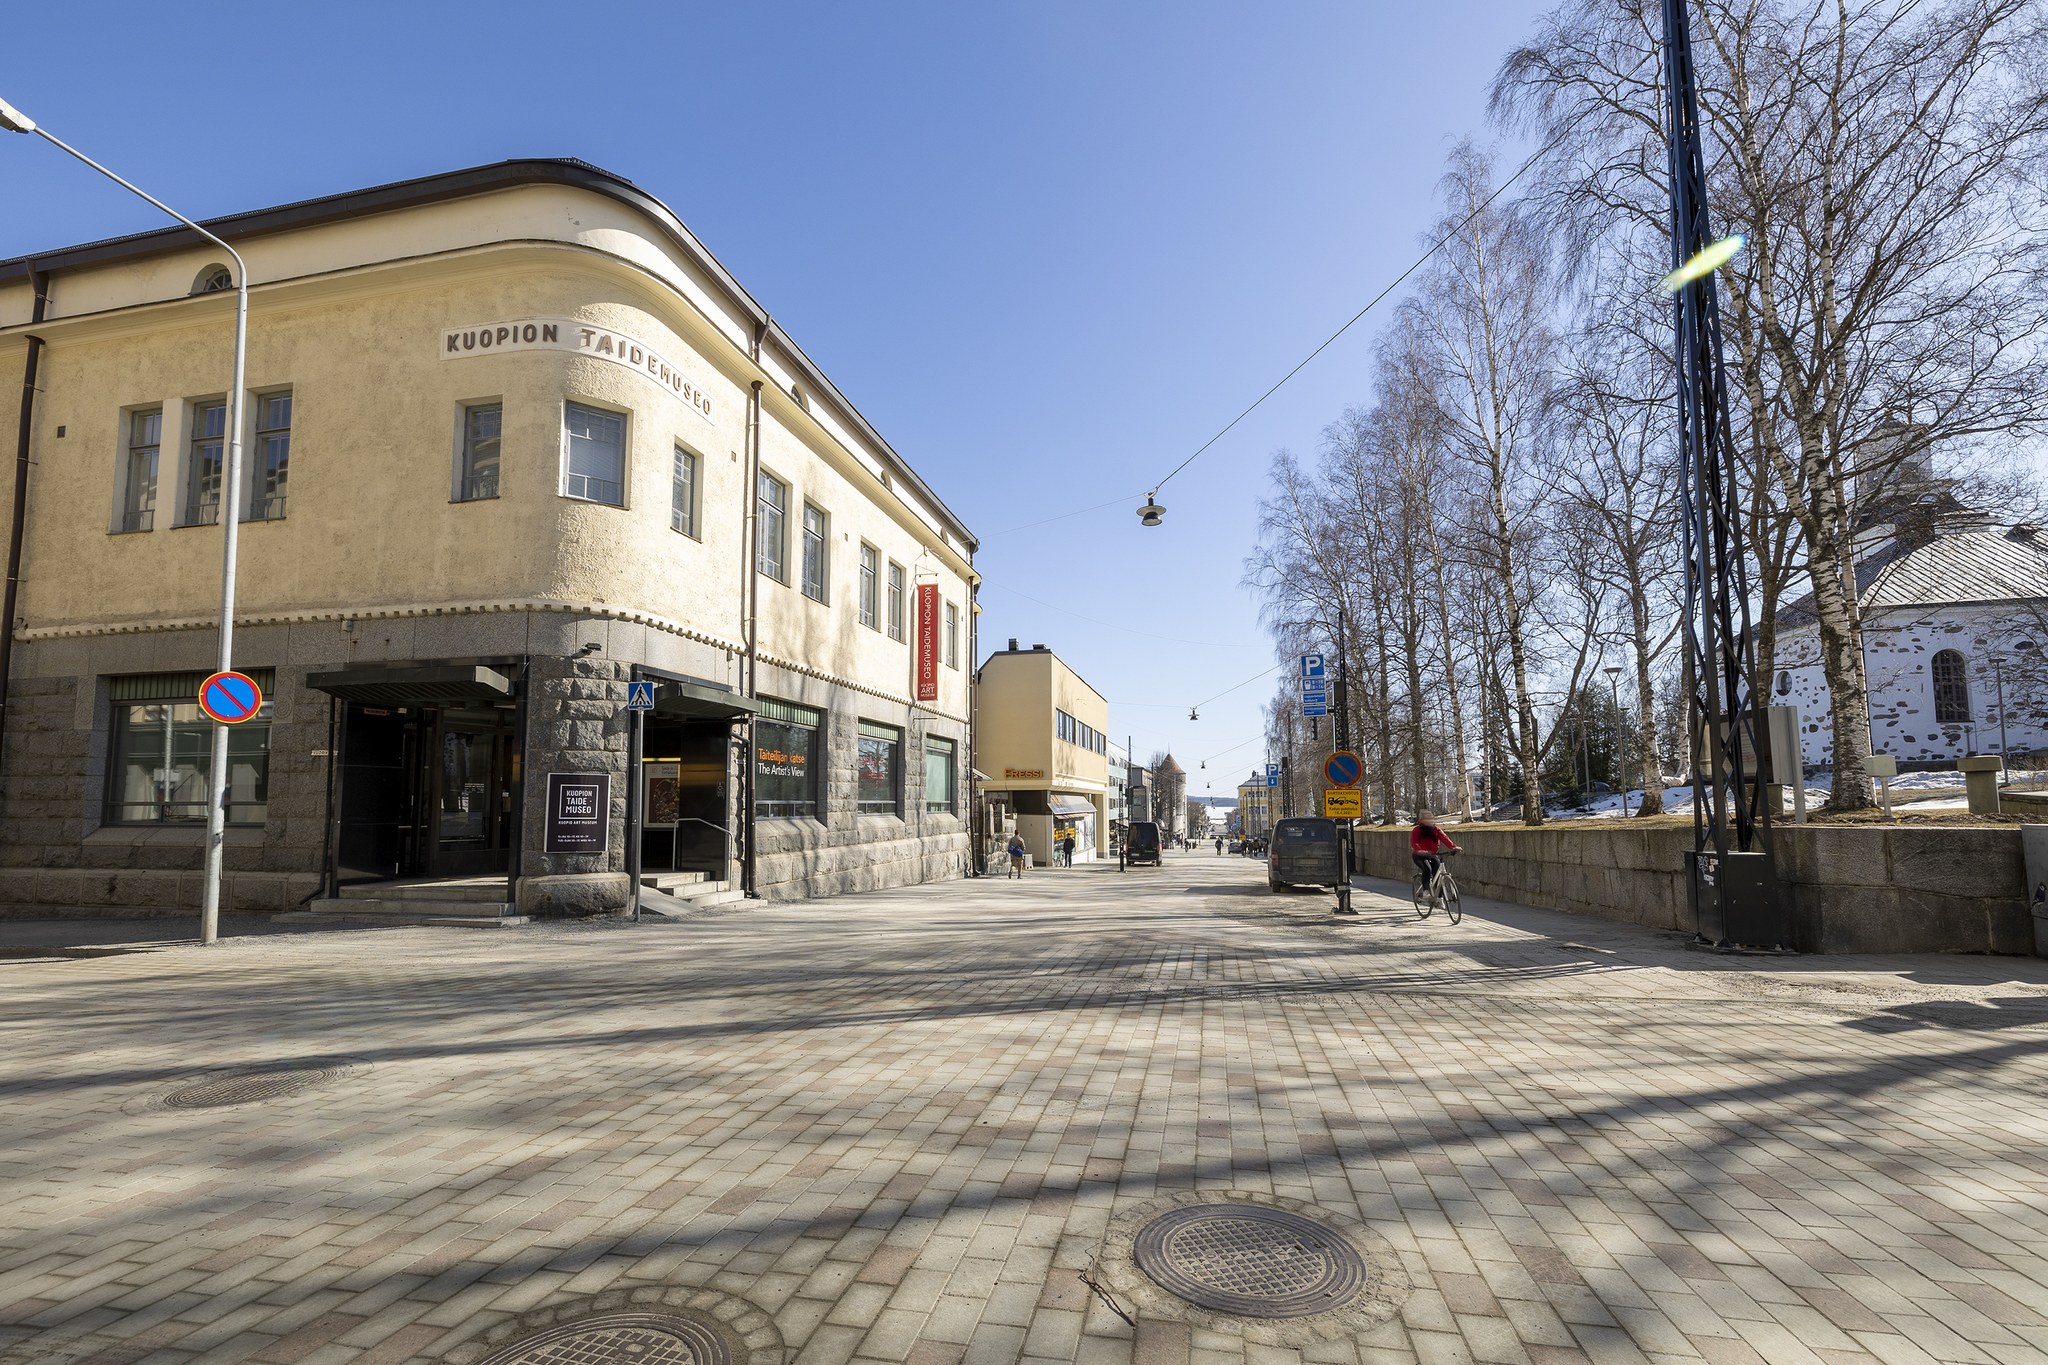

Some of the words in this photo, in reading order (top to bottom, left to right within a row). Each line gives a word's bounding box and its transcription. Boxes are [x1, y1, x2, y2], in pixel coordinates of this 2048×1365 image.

[447, 324, 558, 353] KUOPION
[580, 327, 712, 417] TAIDEMUSEO
[924, 586, 932, 625] KUOPION
[924, 626, 932, 679] TAIDEMUSEO
[1305, 656, 1321, 676] P
[790, 752, 805, 764] katse
[758, 763, 770, 775] The
[771, 765, 790, 776] Artist's
[791, 767, 805, 777] View
[1004, 768, 1043, 779] FRESSI
[1269, 765, 1277, 776] P
[565, 806, 592, 814] MUSEO
